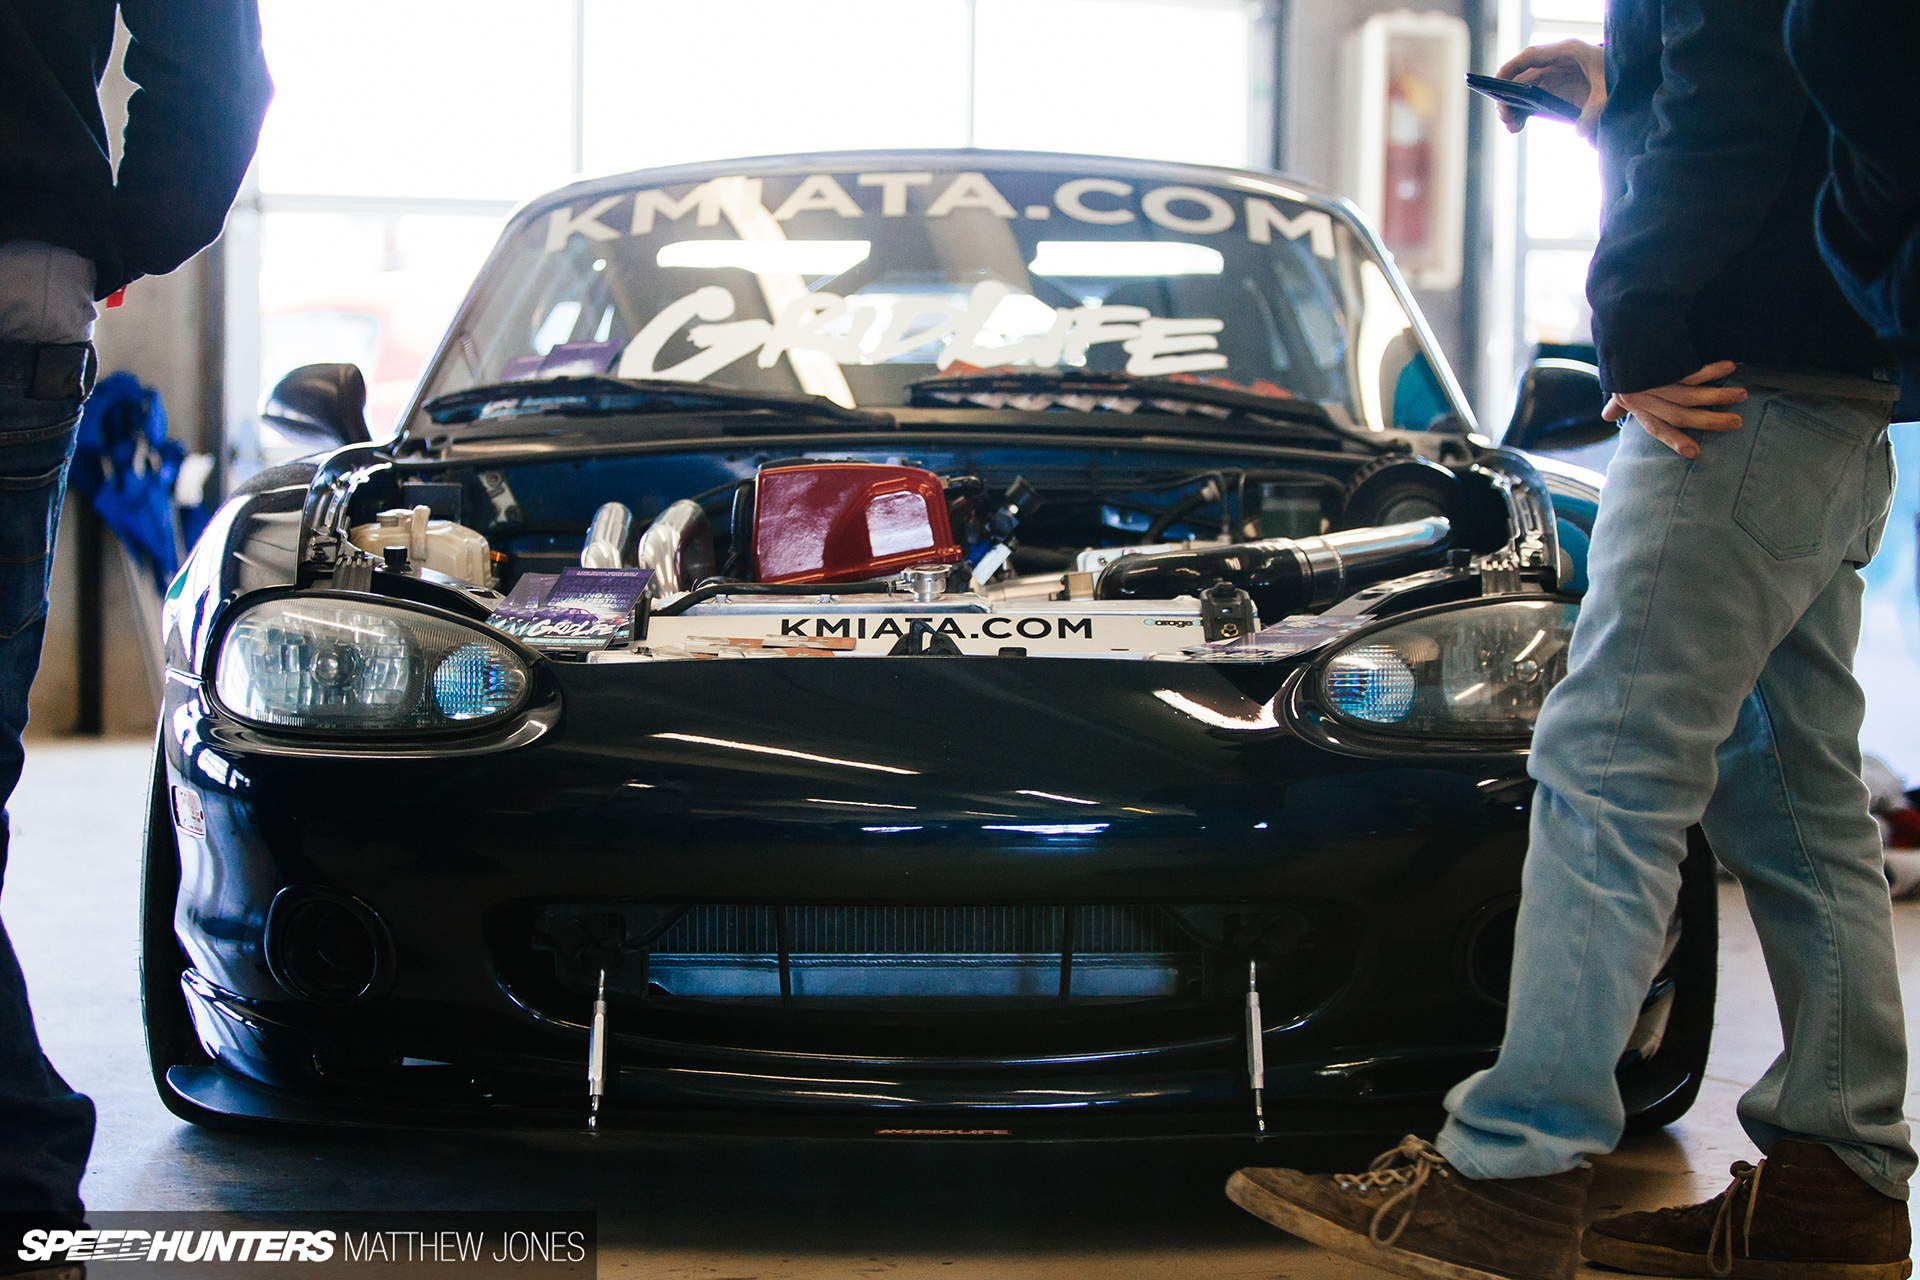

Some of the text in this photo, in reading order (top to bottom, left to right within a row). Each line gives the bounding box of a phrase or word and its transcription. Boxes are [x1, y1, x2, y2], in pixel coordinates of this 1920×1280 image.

[544, 172, 1335, 259] KMIATA.COM
[618, 280, 1228, 379] GRIDLIFE
[526, 619, 616, 636] GRIDLIFE
[781, 617, 1093, 640] KMIATA.COM
